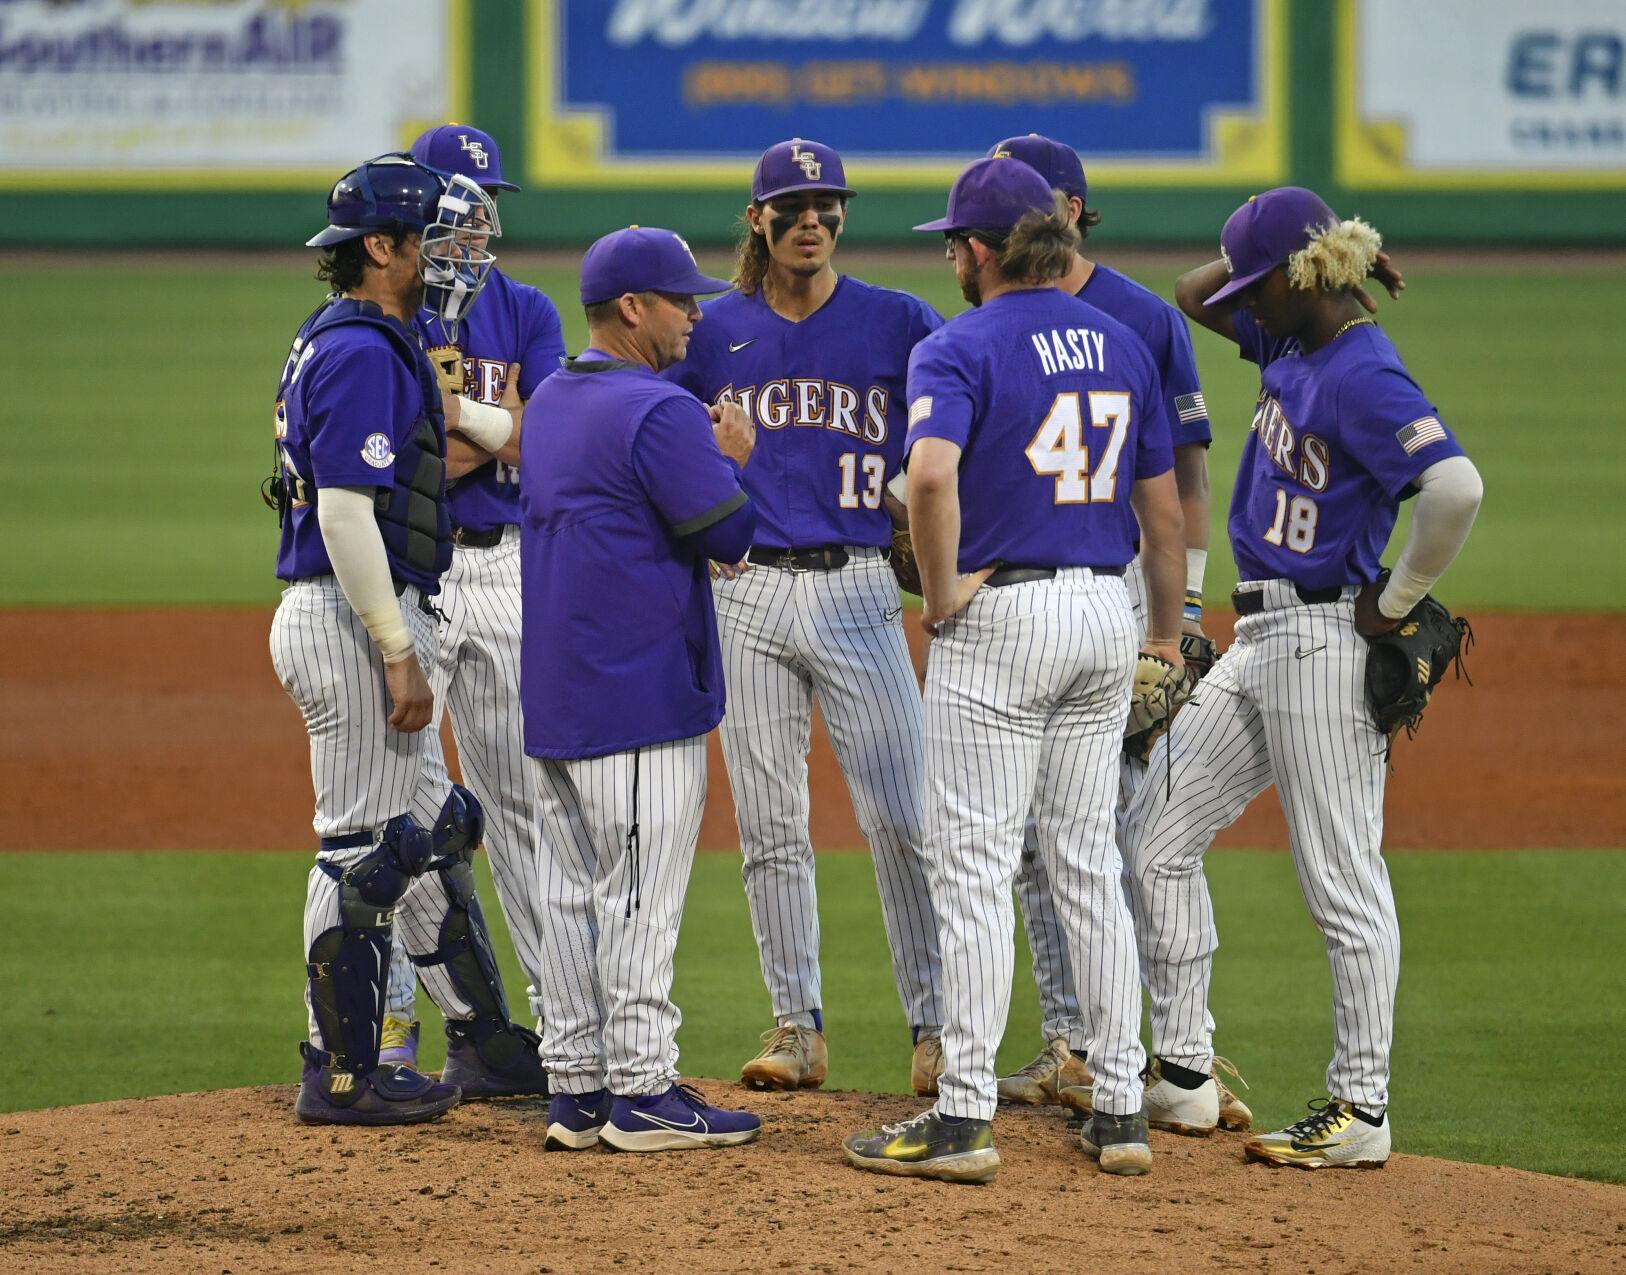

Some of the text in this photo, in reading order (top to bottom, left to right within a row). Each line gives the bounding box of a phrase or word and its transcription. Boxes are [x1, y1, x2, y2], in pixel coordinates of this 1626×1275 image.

[457, 134, 489, 169] LSU
[790, 145, 821, 180] LSU
[1031, 328, 1104, 376] HASTY
[714, 378, 889, 446] IGERS
[367, 434, 389, 459] SEC
[1024, 390, 1131, 504] 47
[838, 453, 886, 509] 13
[1263, 488, 1319, 554] 18
